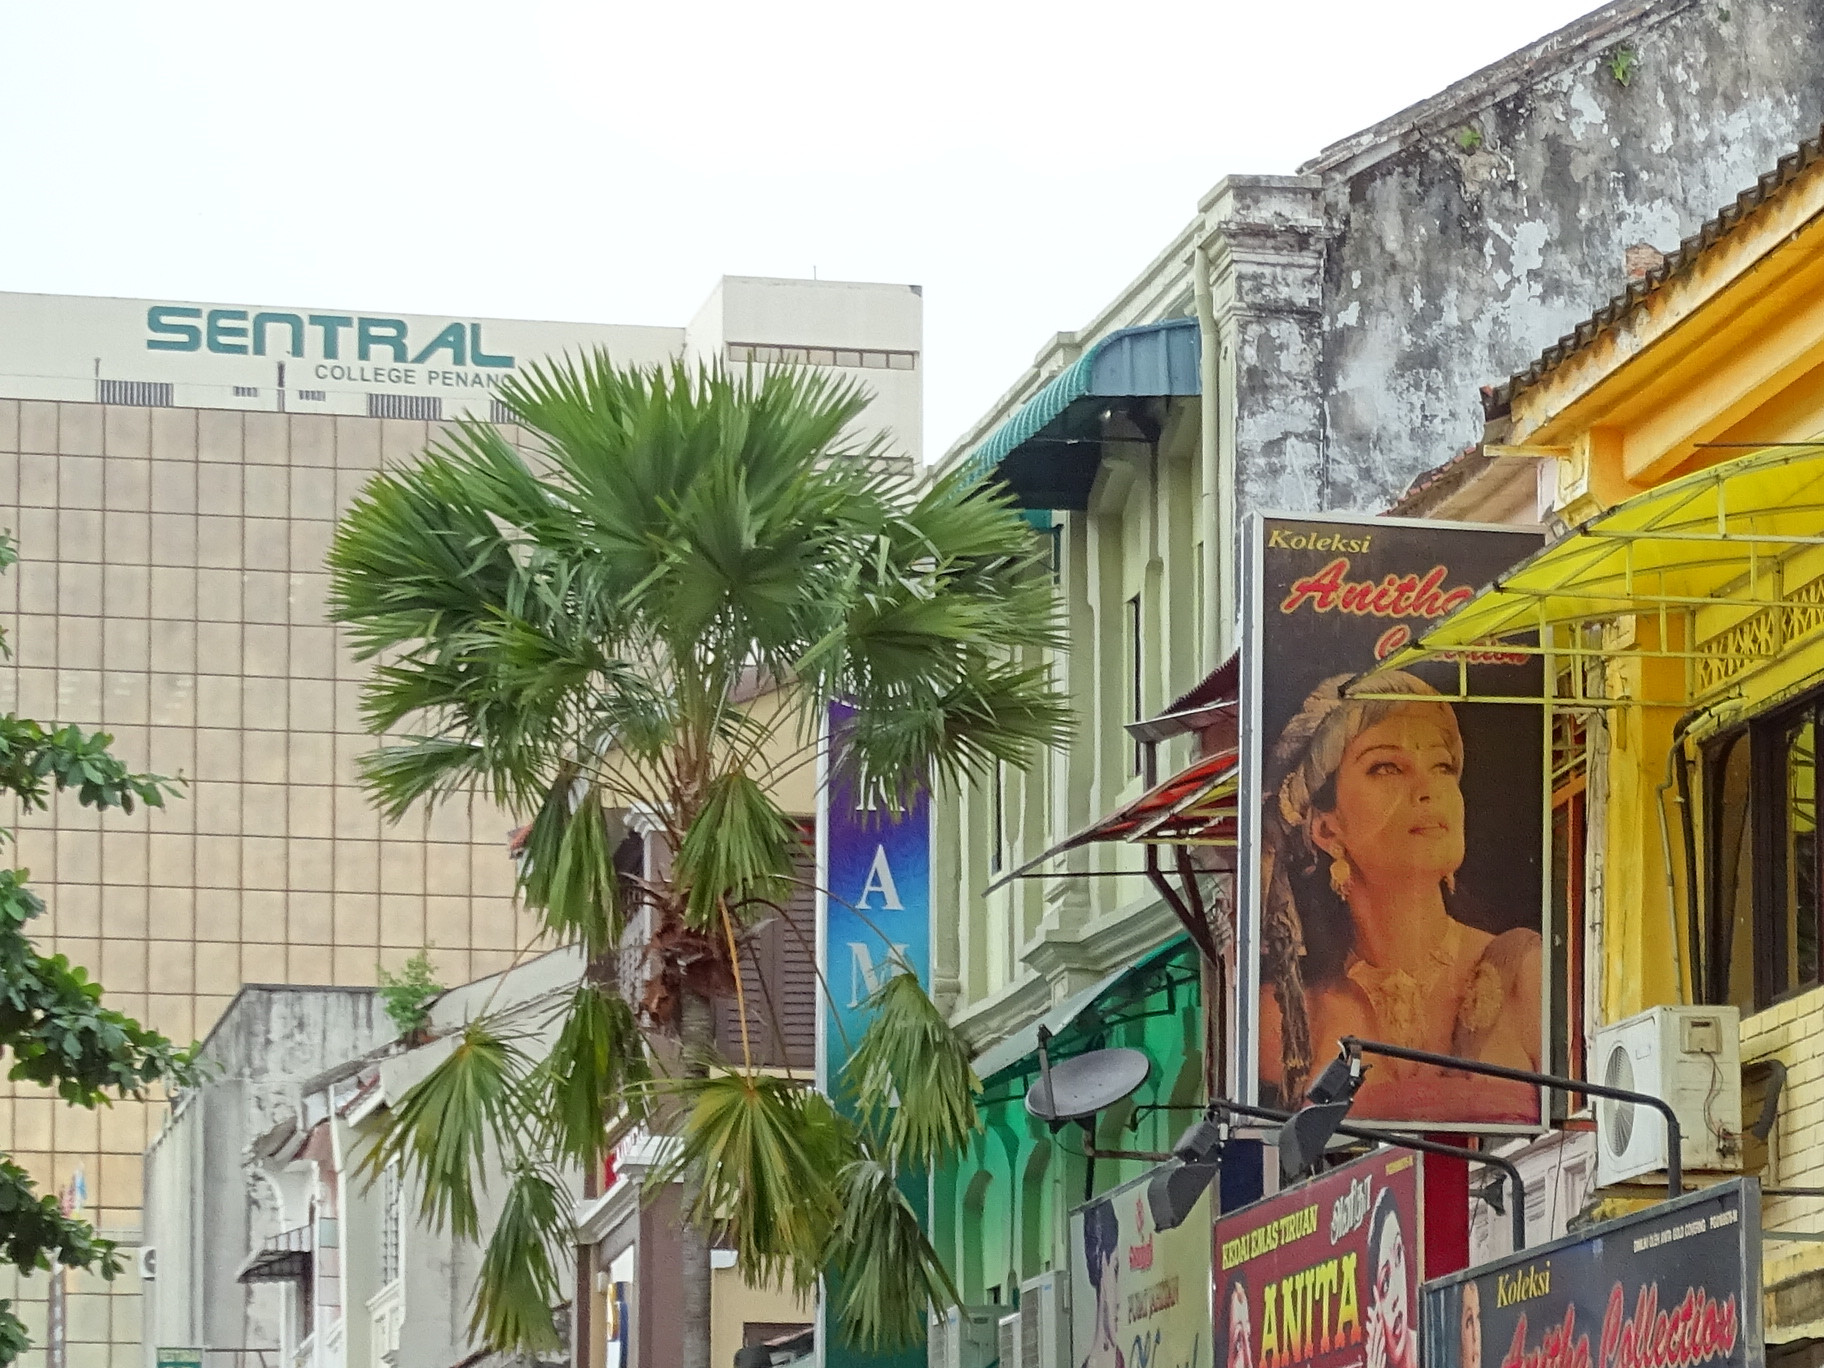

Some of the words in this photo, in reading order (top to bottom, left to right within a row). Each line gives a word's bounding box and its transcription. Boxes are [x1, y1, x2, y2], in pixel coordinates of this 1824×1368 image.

[146, 305, 515, 369] SENTRAL
[314, 364, 416, 386] COLLEGE
[1268, 529, 1372, 554] Koleksi
[1496, 1261, 1551, 1308] Koleksi
